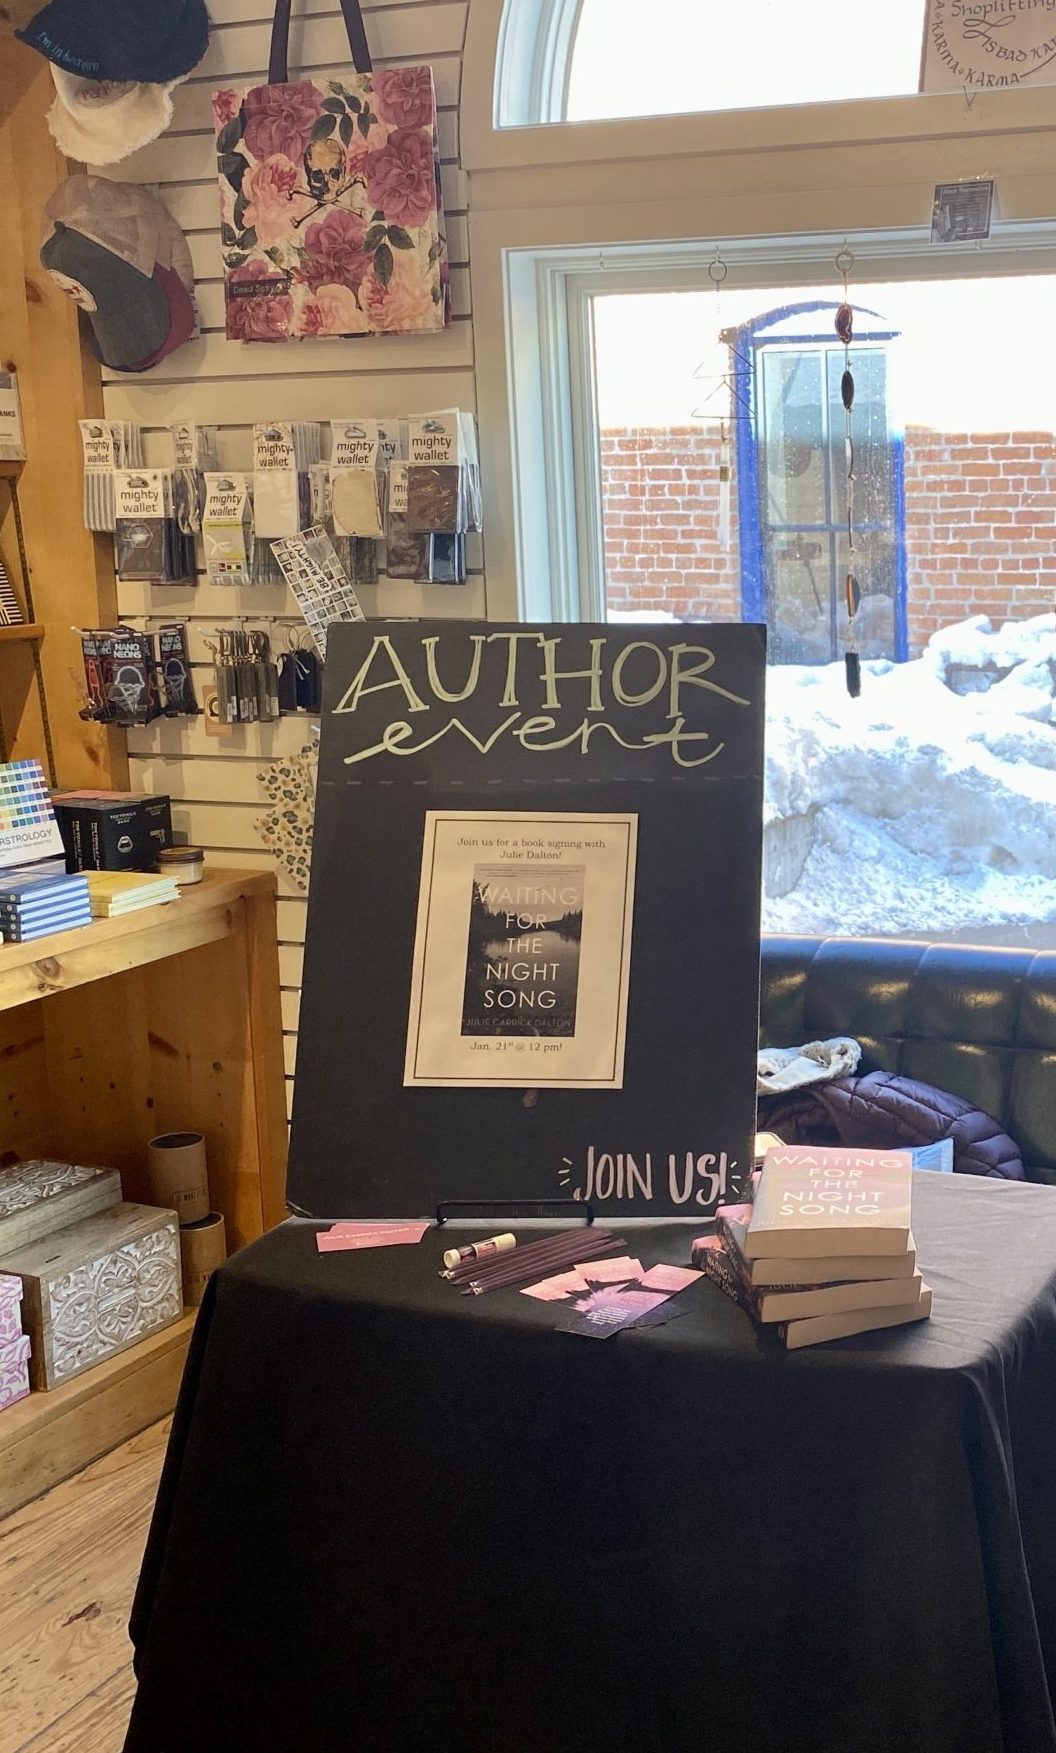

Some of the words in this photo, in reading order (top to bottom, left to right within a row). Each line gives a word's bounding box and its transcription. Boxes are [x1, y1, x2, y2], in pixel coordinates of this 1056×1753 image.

[964, 67, 1020, 87] KARMA
[337, 440, 375, 454] mighty
[412, 435, 451, 448] mighty
[257, 443, 290, 456] mighty
[414, 450, 449, 460] wallet
[337, 454, 369, 464] wallet
[120, 490, 159, 502] mighty
[209, 494, 242, 505] mighty
[123, 504, 158, 513] wallet
[209, 507, 238, 516] wallet
[114, 643, 140, 651] NANO
[332, 633, 751, 718] AUTHOR
[344, 711, 725, 768] event
[457, 838, 478, 847] Join
[496, 838, 510, 847] for
[521, 838, 544, 847] book
[547, 839, 582, 849] signing
[584, 839, 606, 848] with
[499, 851, 523, 860] Julie
[477, 886, 578, 905] WAITING
[505, 913, 546, 929] FOR
[507, 938, 542, 954] THE
[486, 963, 560, 981] NIGHT
[483, 990, 557, 1008] SONG
[534, 1018, 571, 1026] DALTON
[529, 1043, 541, 1051] 12
[773, 1155, 905, 1168] WAITING
[573, 1146, 652, 1201] JOIN
[668, 1151, 728, 1205] US!
[809, 1168, 863, 1178] FOR
[810, 1180, 859, 1189] THE
[783, 1191, 884, 1202] NIGHT
[779, 1204, 881, 1216] SONG
